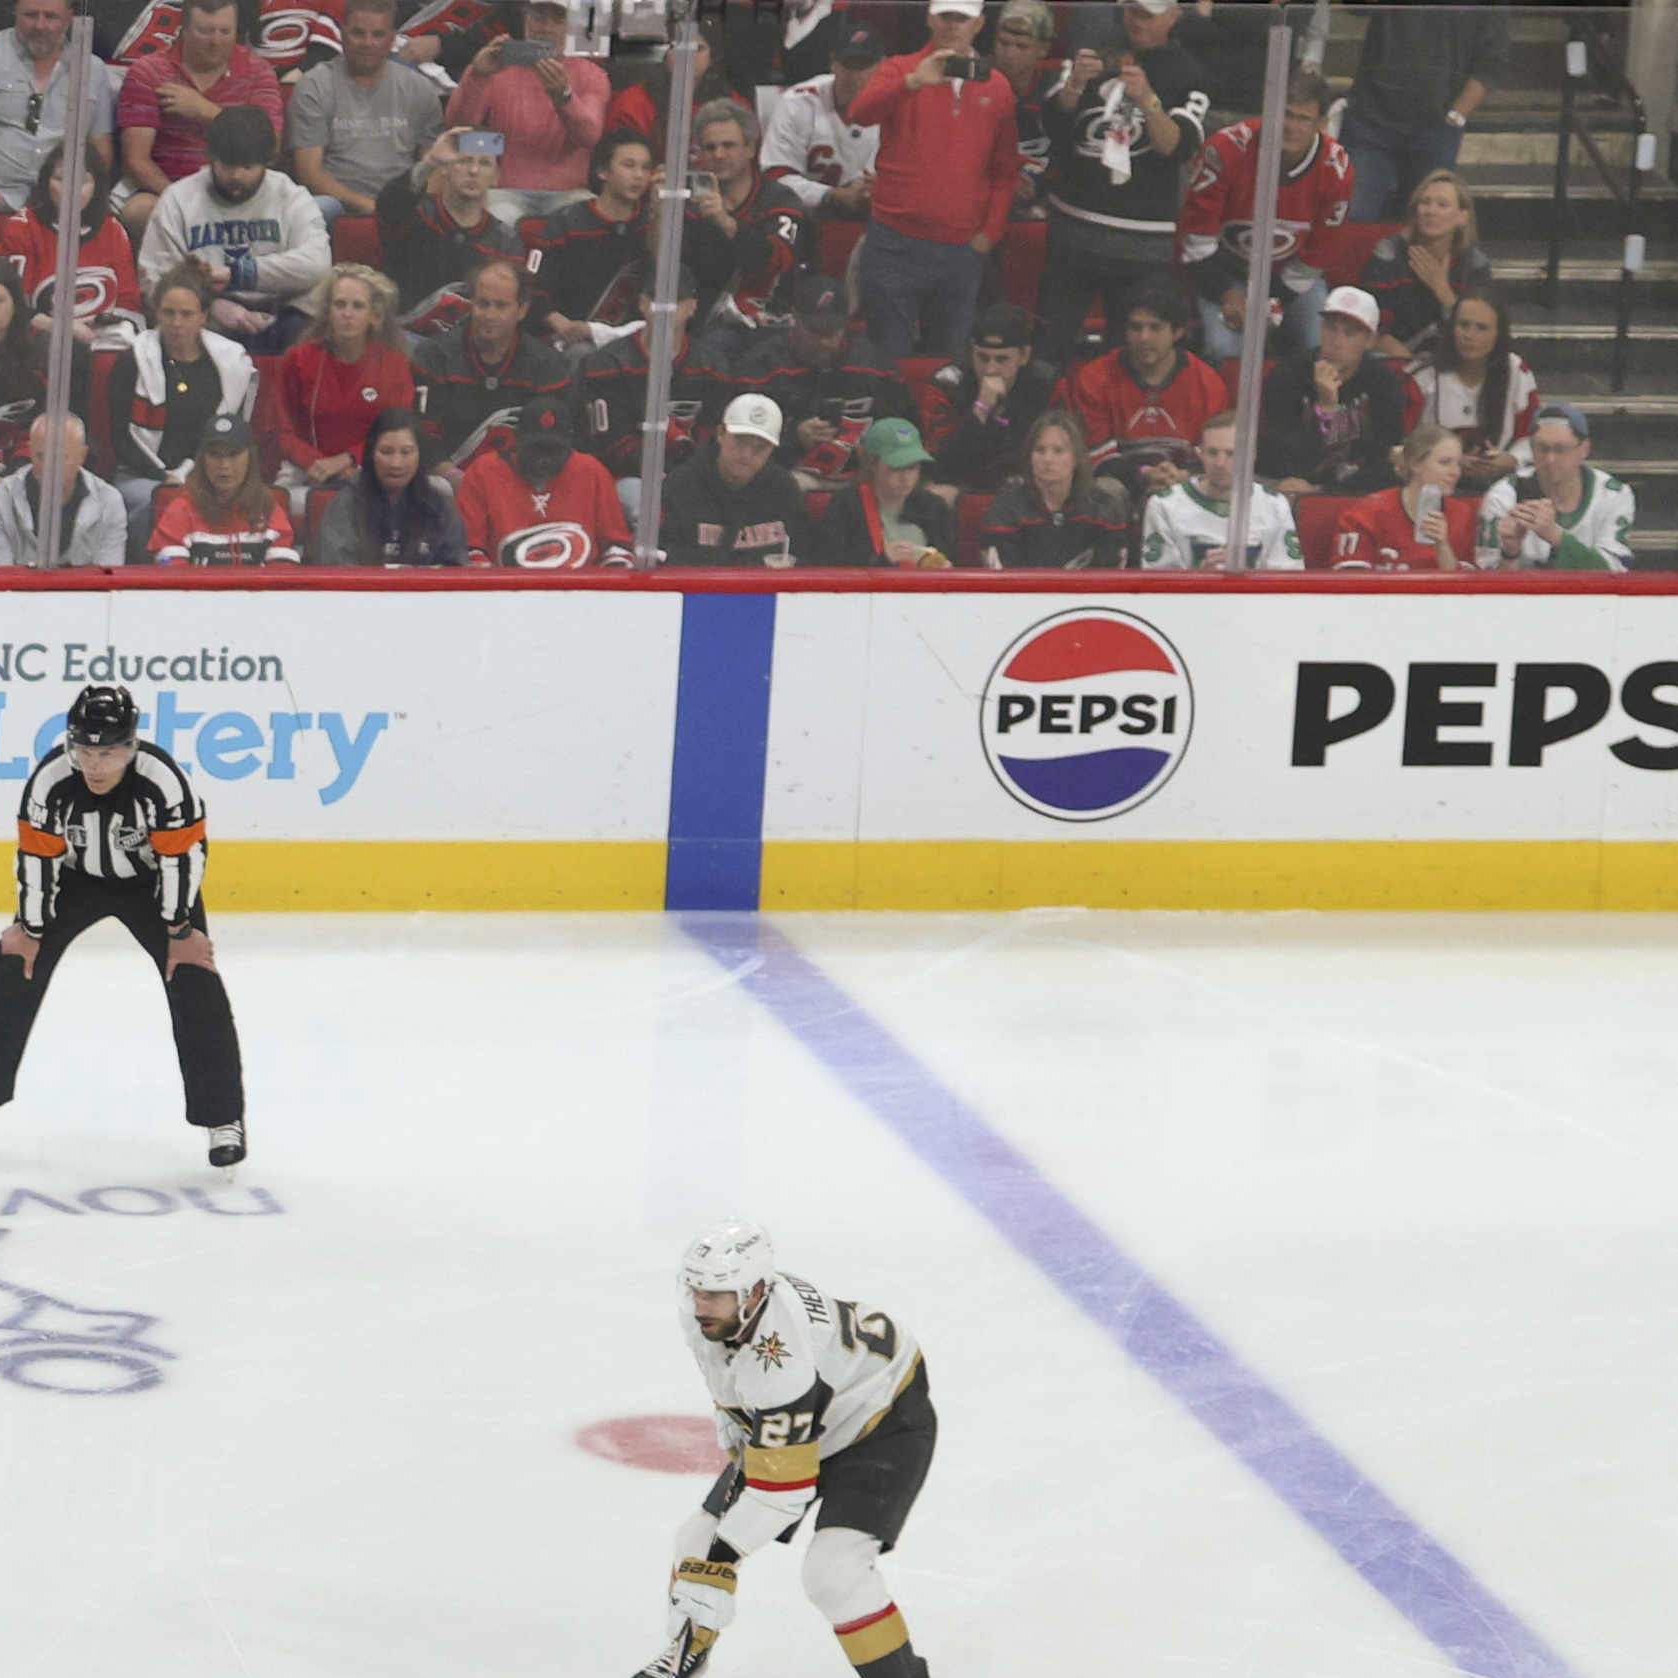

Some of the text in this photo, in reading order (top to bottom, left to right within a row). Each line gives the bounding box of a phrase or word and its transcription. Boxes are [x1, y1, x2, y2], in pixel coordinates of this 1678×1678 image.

[62, 643, 283, 682] Education
[997, 694, 1176, 736] PEPSI
[758, 1411, 814, 1448] 27
[677, 1560, 736, 1583] BAUE
